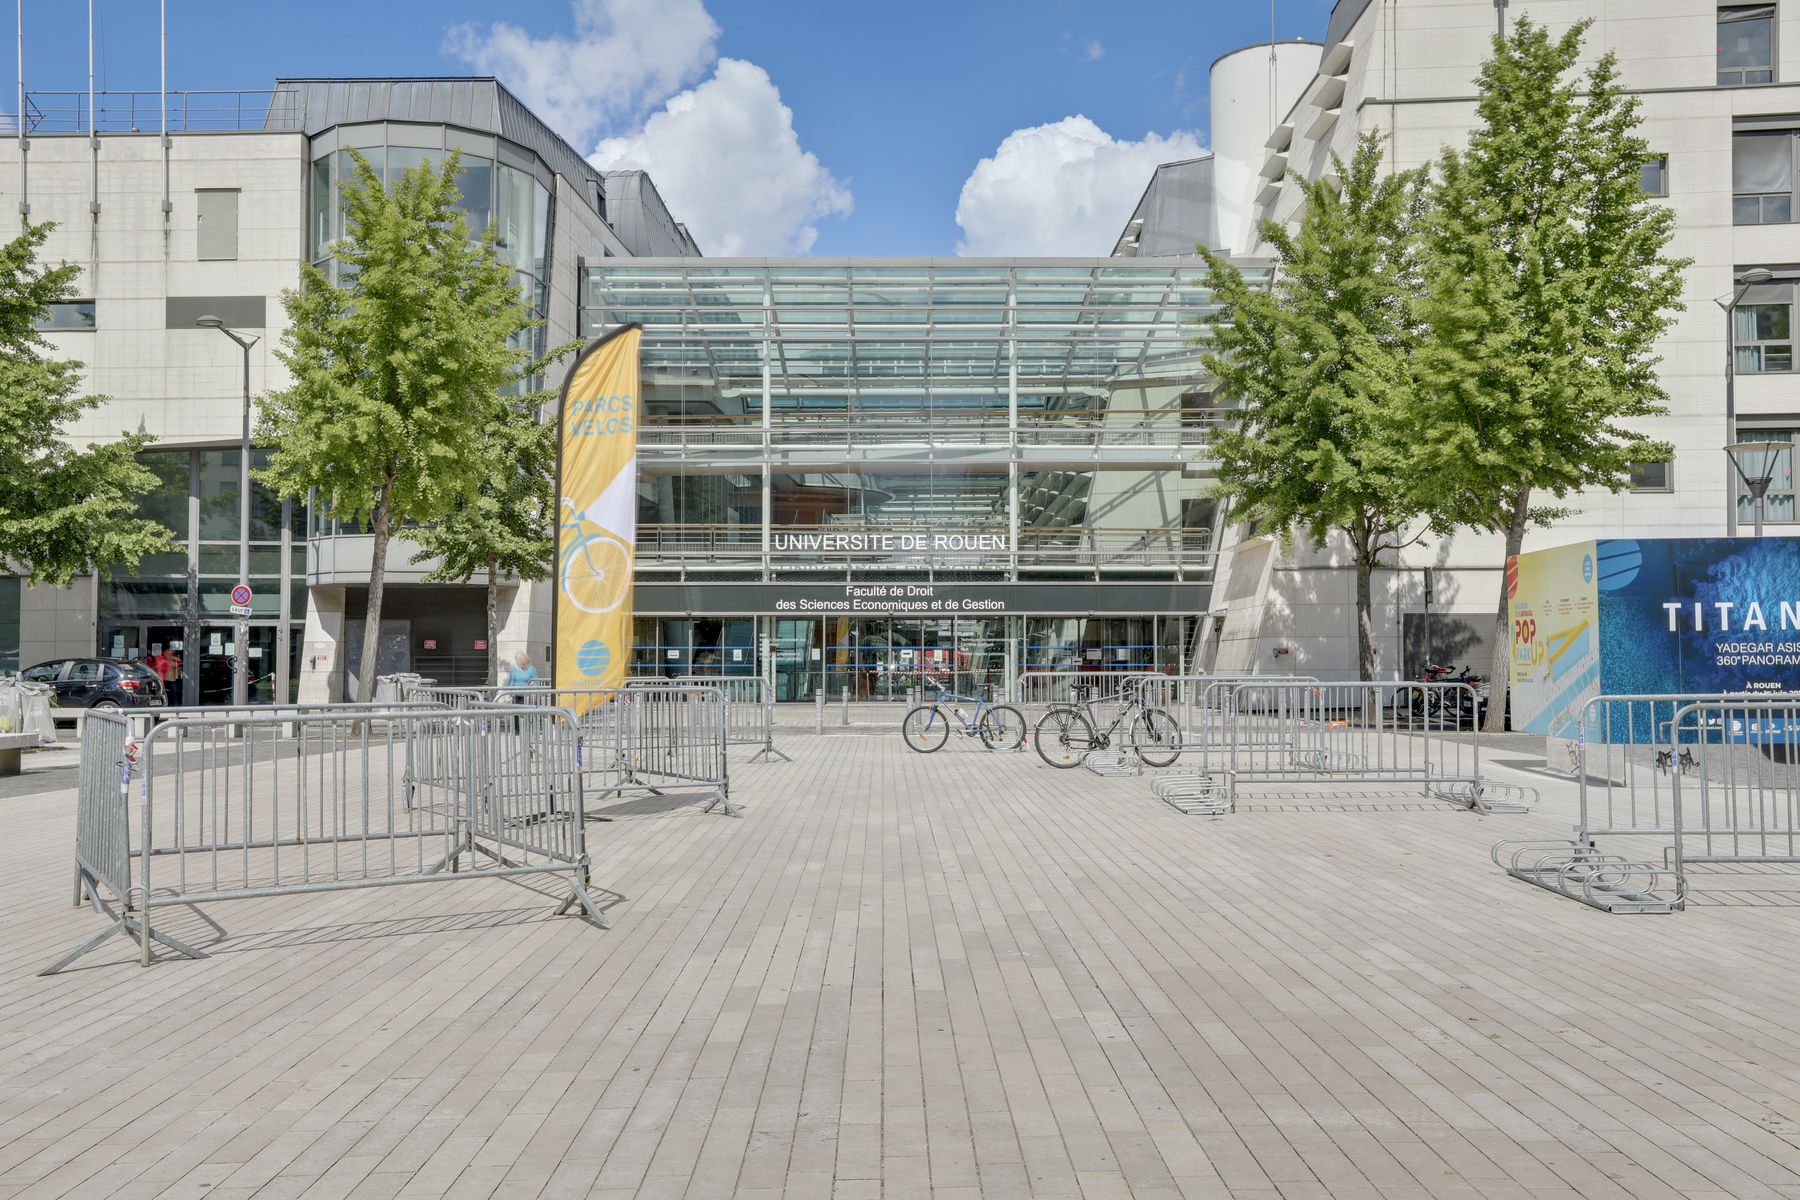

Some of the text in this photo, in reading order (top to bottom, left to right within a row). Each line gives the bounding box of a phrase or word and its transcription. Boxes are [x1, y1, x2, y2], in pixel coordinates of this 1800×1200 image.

[572, 394, 633, 416] PARCS
[775, 534, 1005, 550] UNIVERSITE DE ROUEN
[846, 585, 934, 597] Faculté de Droit
[776, 599, 1005, 613] des Sciences Economiques et de Gestion
[1663, 601, 1800, 632] TITAN
[1515, 619, 1536, 645] POP
[1716, 642, 1774, 653] YADEGAR
[1745, 681, 1752, 689] À
